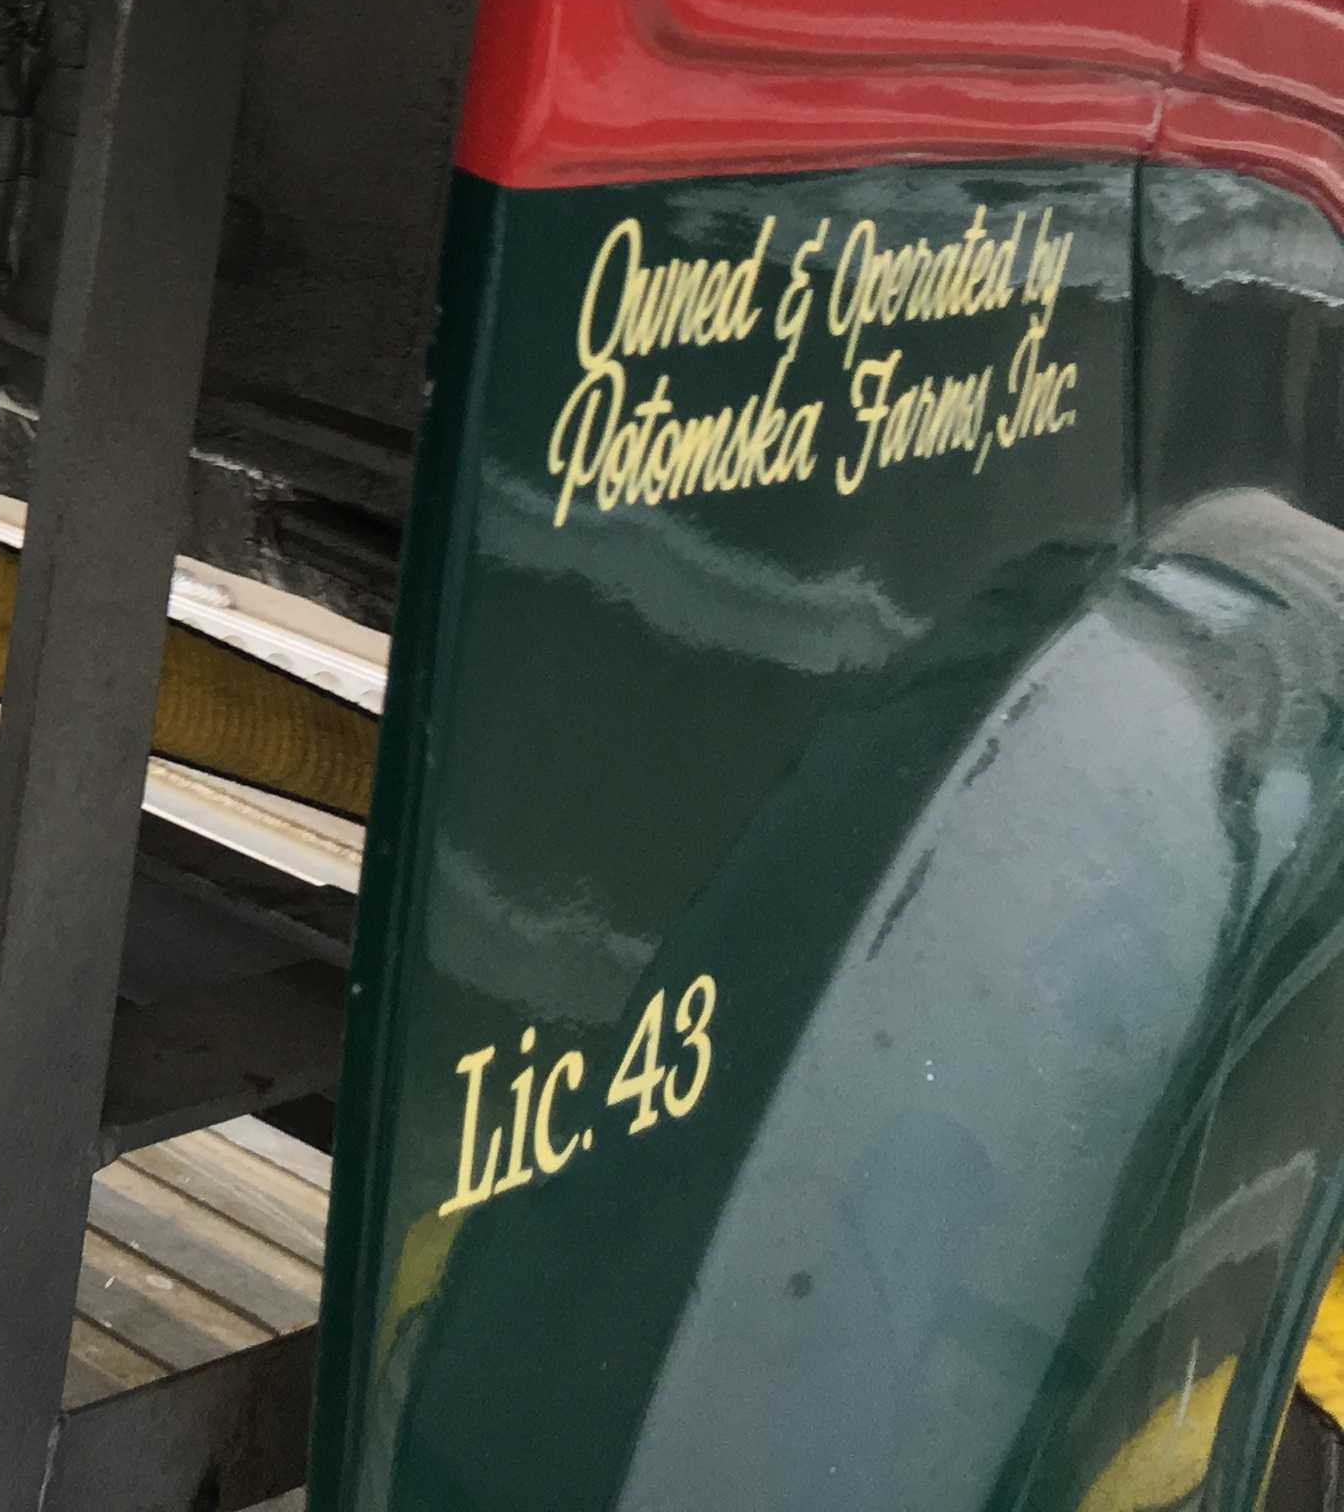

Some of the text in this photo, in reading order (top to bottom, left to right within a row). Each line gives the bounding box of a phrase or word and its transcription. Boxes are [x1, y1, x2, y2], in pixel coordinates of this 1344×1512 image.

[577, 205, 1075, 370] Owned & Operated by
[548, 354, 820, 528] Potomska
[836, 348, 994, 496] Farms,
[438, 973, 717, 1217] Lic. 43
